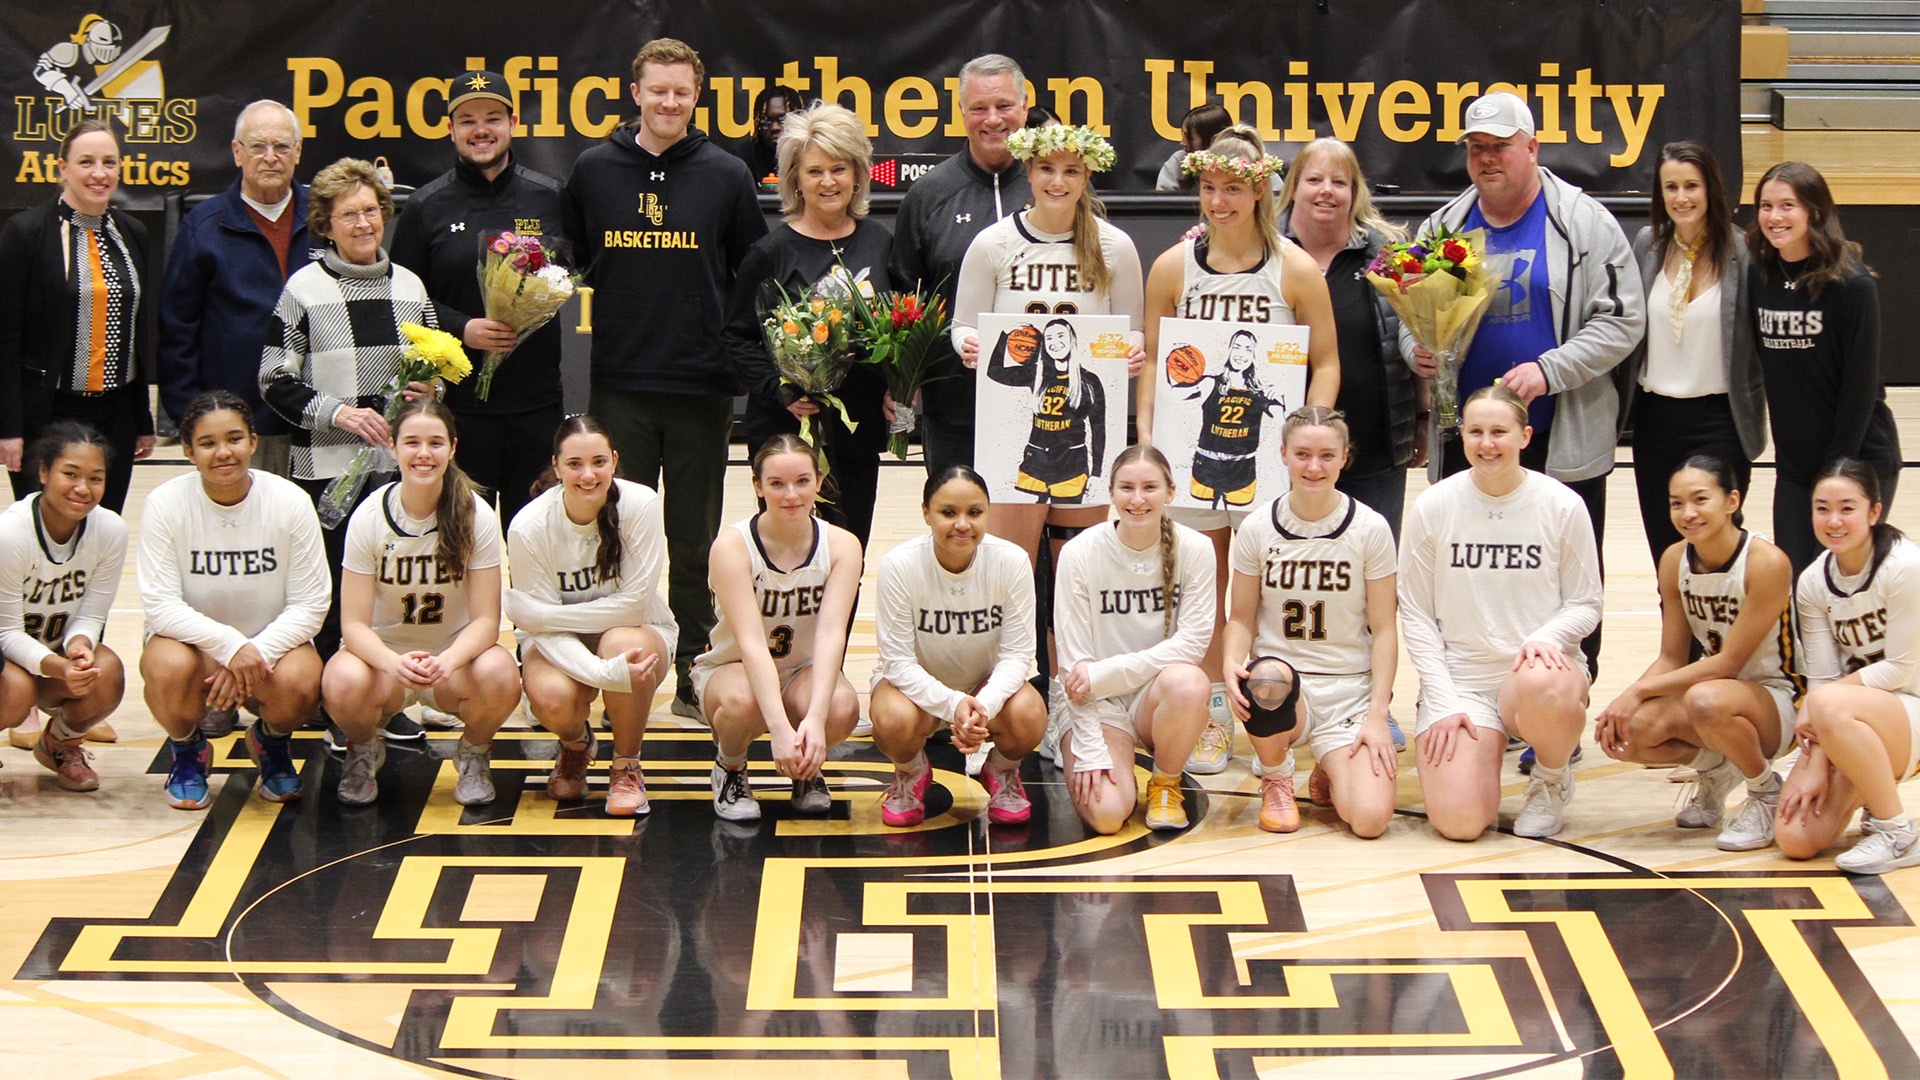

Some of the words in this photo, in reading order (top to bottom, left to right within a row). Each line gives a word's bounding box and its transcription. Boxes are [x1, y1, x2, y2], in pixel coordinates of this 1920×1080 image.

[286, 55, 621, 139] Pacfic
[694, 55, 1111, 139] uthen
[1144, 58, 1665, 168] Univerity
[15, 151, 191, 187] Attics
[513, 218, 541, 231] PLU
[604, 230, 699, 249] BASKETBALL
[1185, 294, 1271, 324] LUTES
[1758, 306, 1824, 336] LUTES
[1762, 336, 1816, 350] BASKETBALL
[1041, 396, 1064, 416] 32
[1218, 396, 1253, 407] PACIFIC
[1219, 405, 1245, 424] 22
[1210, 424, 1250, 438] LUTHERAN
[189, 547, 278, 576] LUTES
[379, 554, 464, 586] LUTE
[1450, 543, 1542, 569] LUTES
[1265, 560, 1352, 592] LUTES
[400, 592, 445, 625] 12
[754, 585, 825, 618] UTES
[917, 604, 1003, 635] LUTES
[1281, 598, 1327, 641] 21
[1834, 607, 1887, 648] UTES
[768, 624, 795, 659] 3
